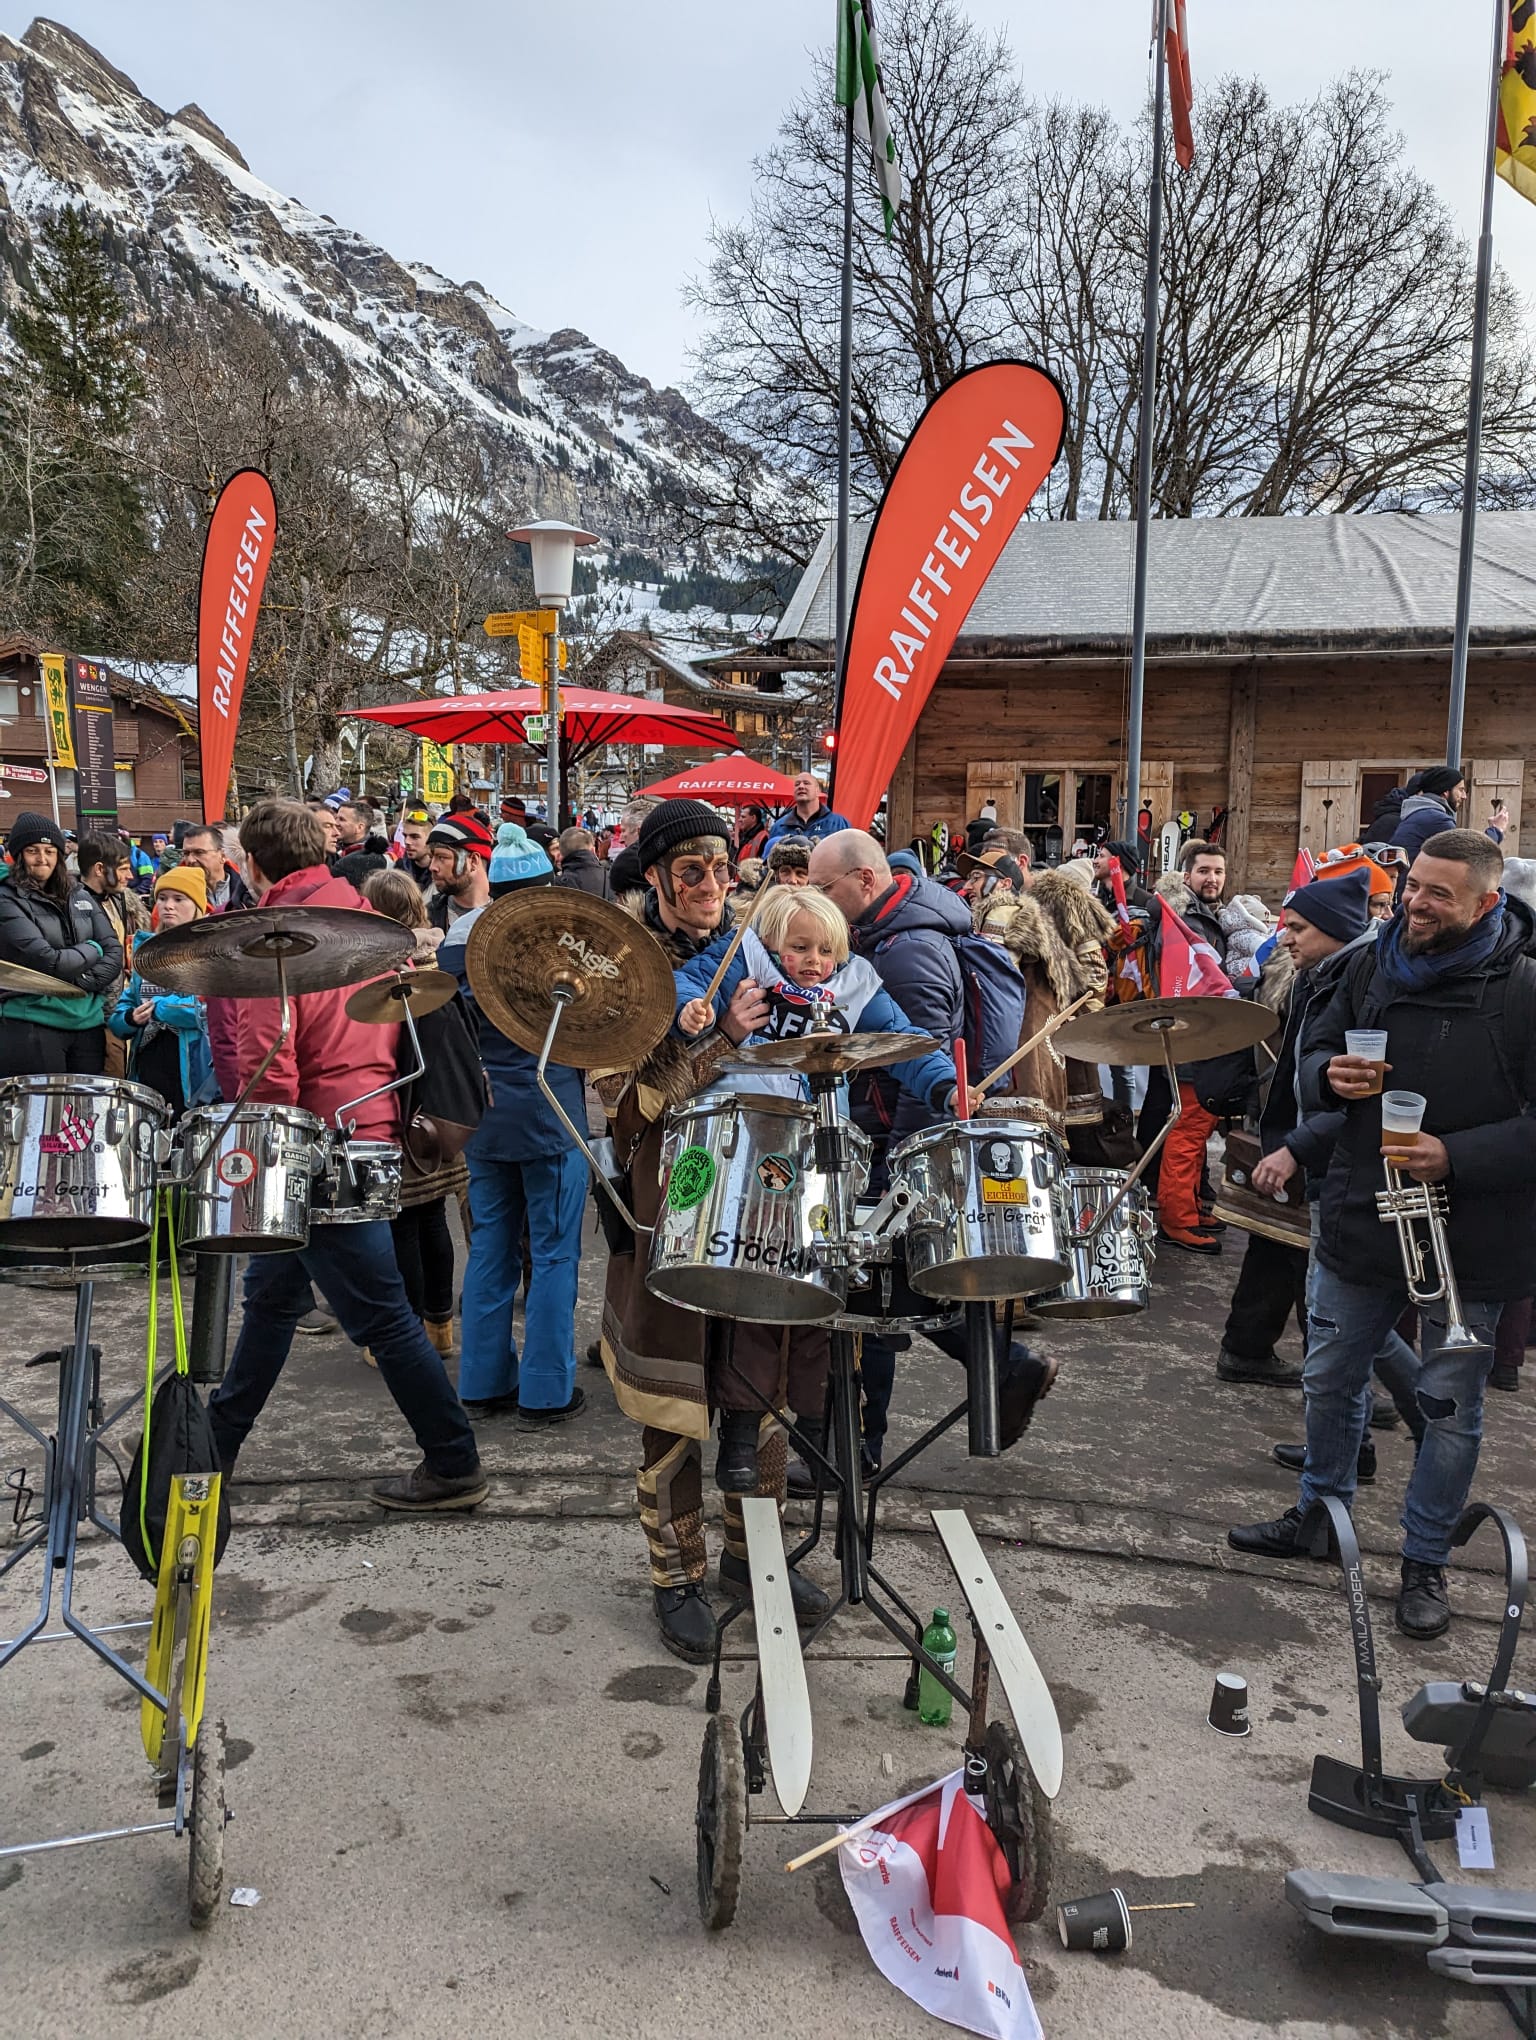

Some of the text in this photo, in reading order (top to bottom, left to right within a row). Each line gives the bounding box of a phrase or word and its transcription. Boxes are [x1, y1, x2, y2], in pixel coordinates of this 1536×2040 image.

[872, 419, 1035, 701] RAIFFEISEN
[211, 505, 267, 719] RAIFFEISEN
[79, 682, 108, 694] WENGEN
[439, 701, 632, 710] RAIFFSEN
[678, 780, 775, 790] RAIFFEISEN
[889, 1916, 922, 1963] RAIFFEISEN
